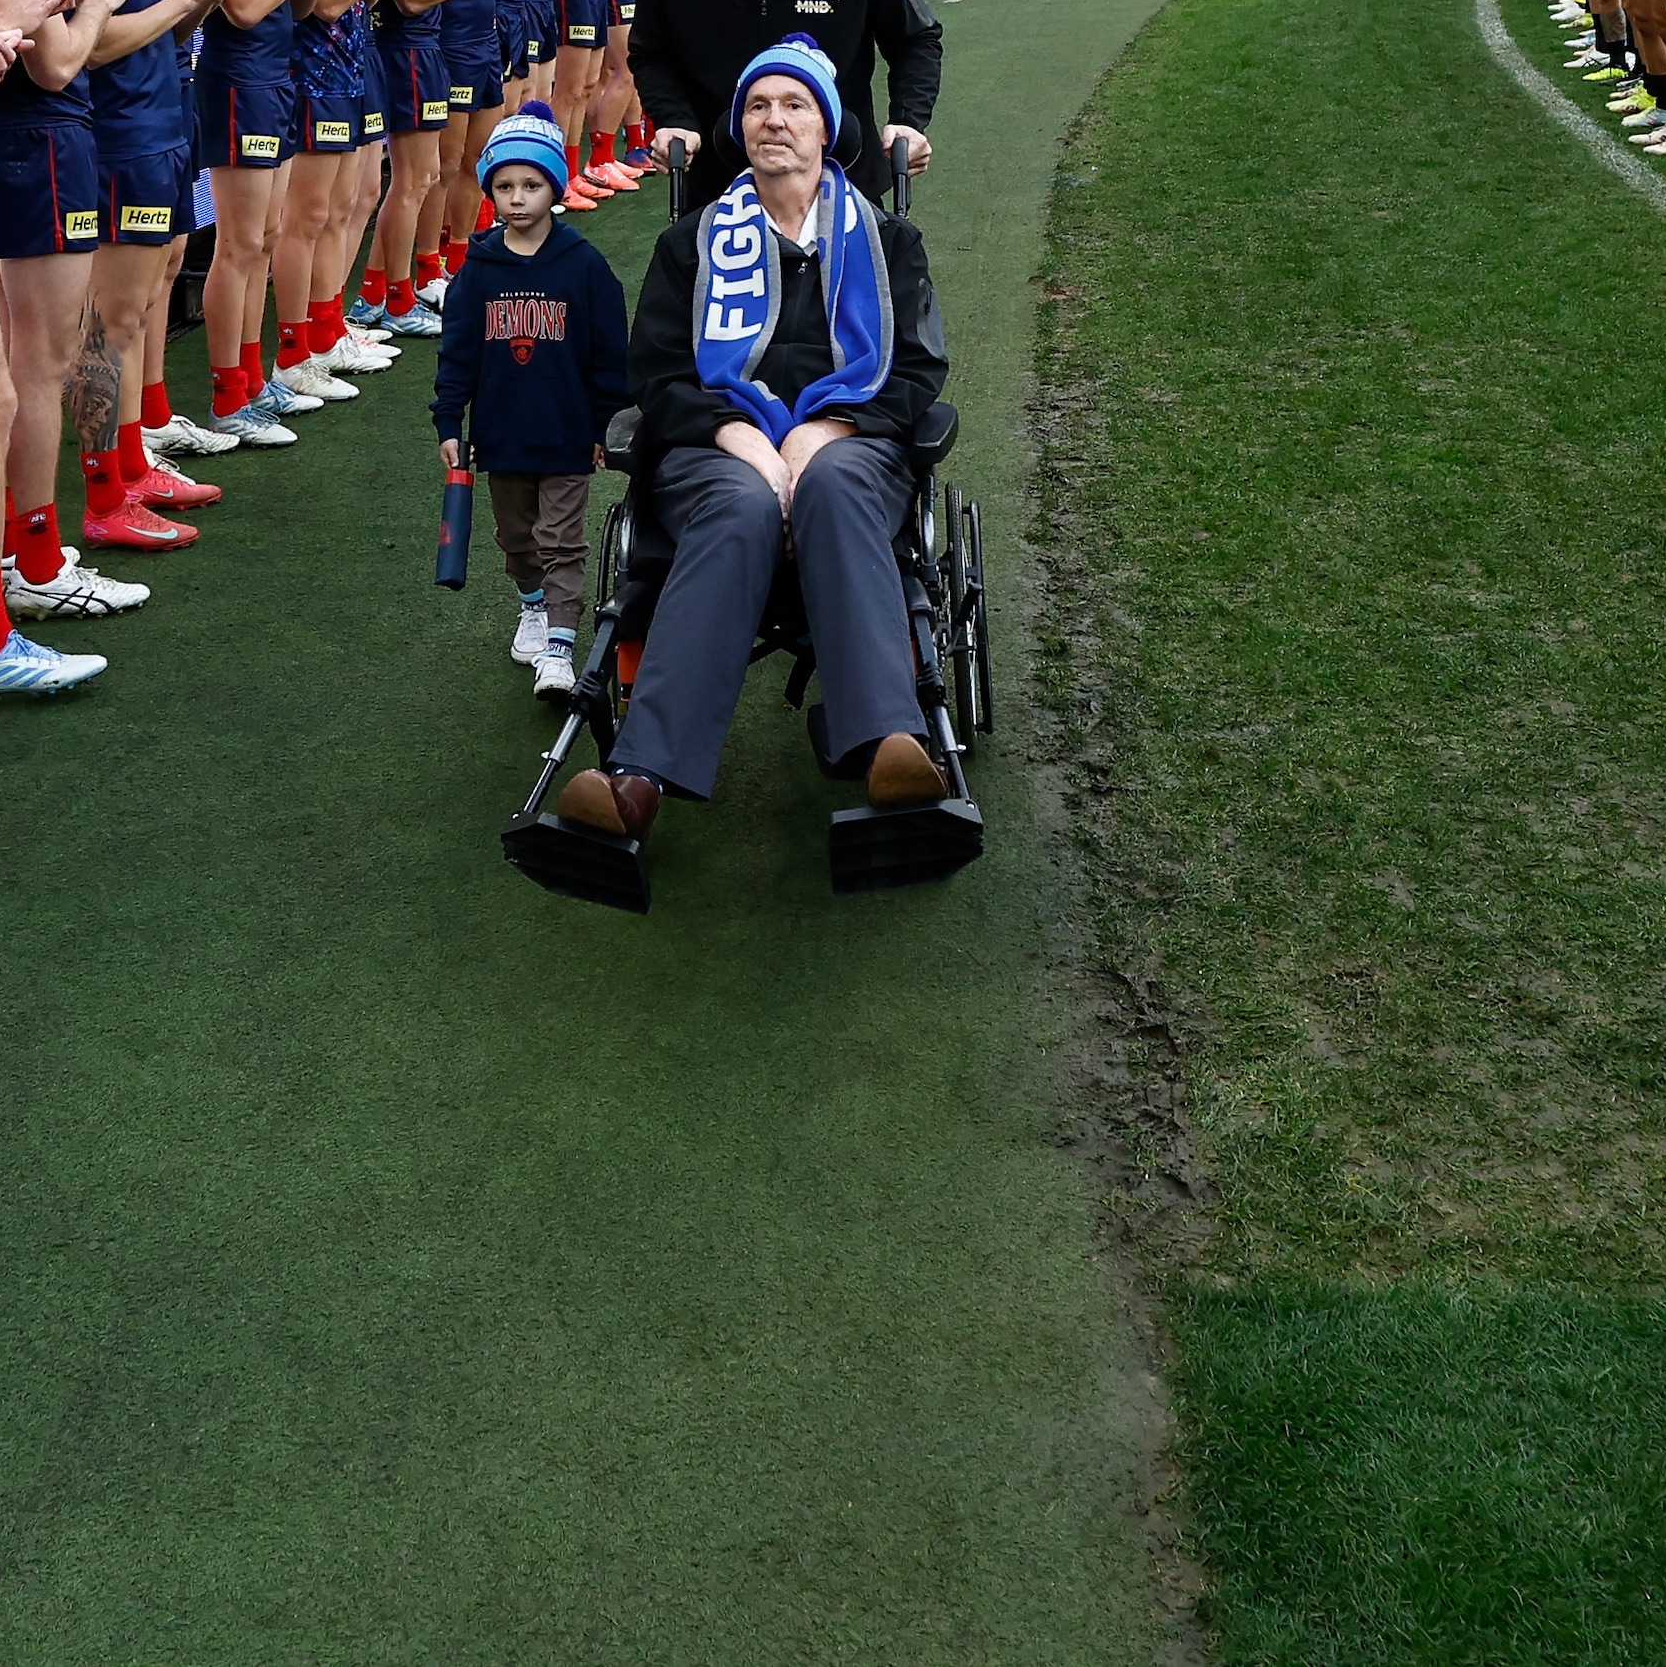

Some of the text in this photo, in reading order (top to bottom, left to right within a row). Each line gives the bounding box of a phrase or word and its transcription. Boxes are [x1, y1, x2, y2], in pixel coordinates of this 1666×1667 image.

[247, 138, 277, 152] Hertz
[127, 210, 168, 229] Hertz
[485, 299, 568, 342] DEMONS
